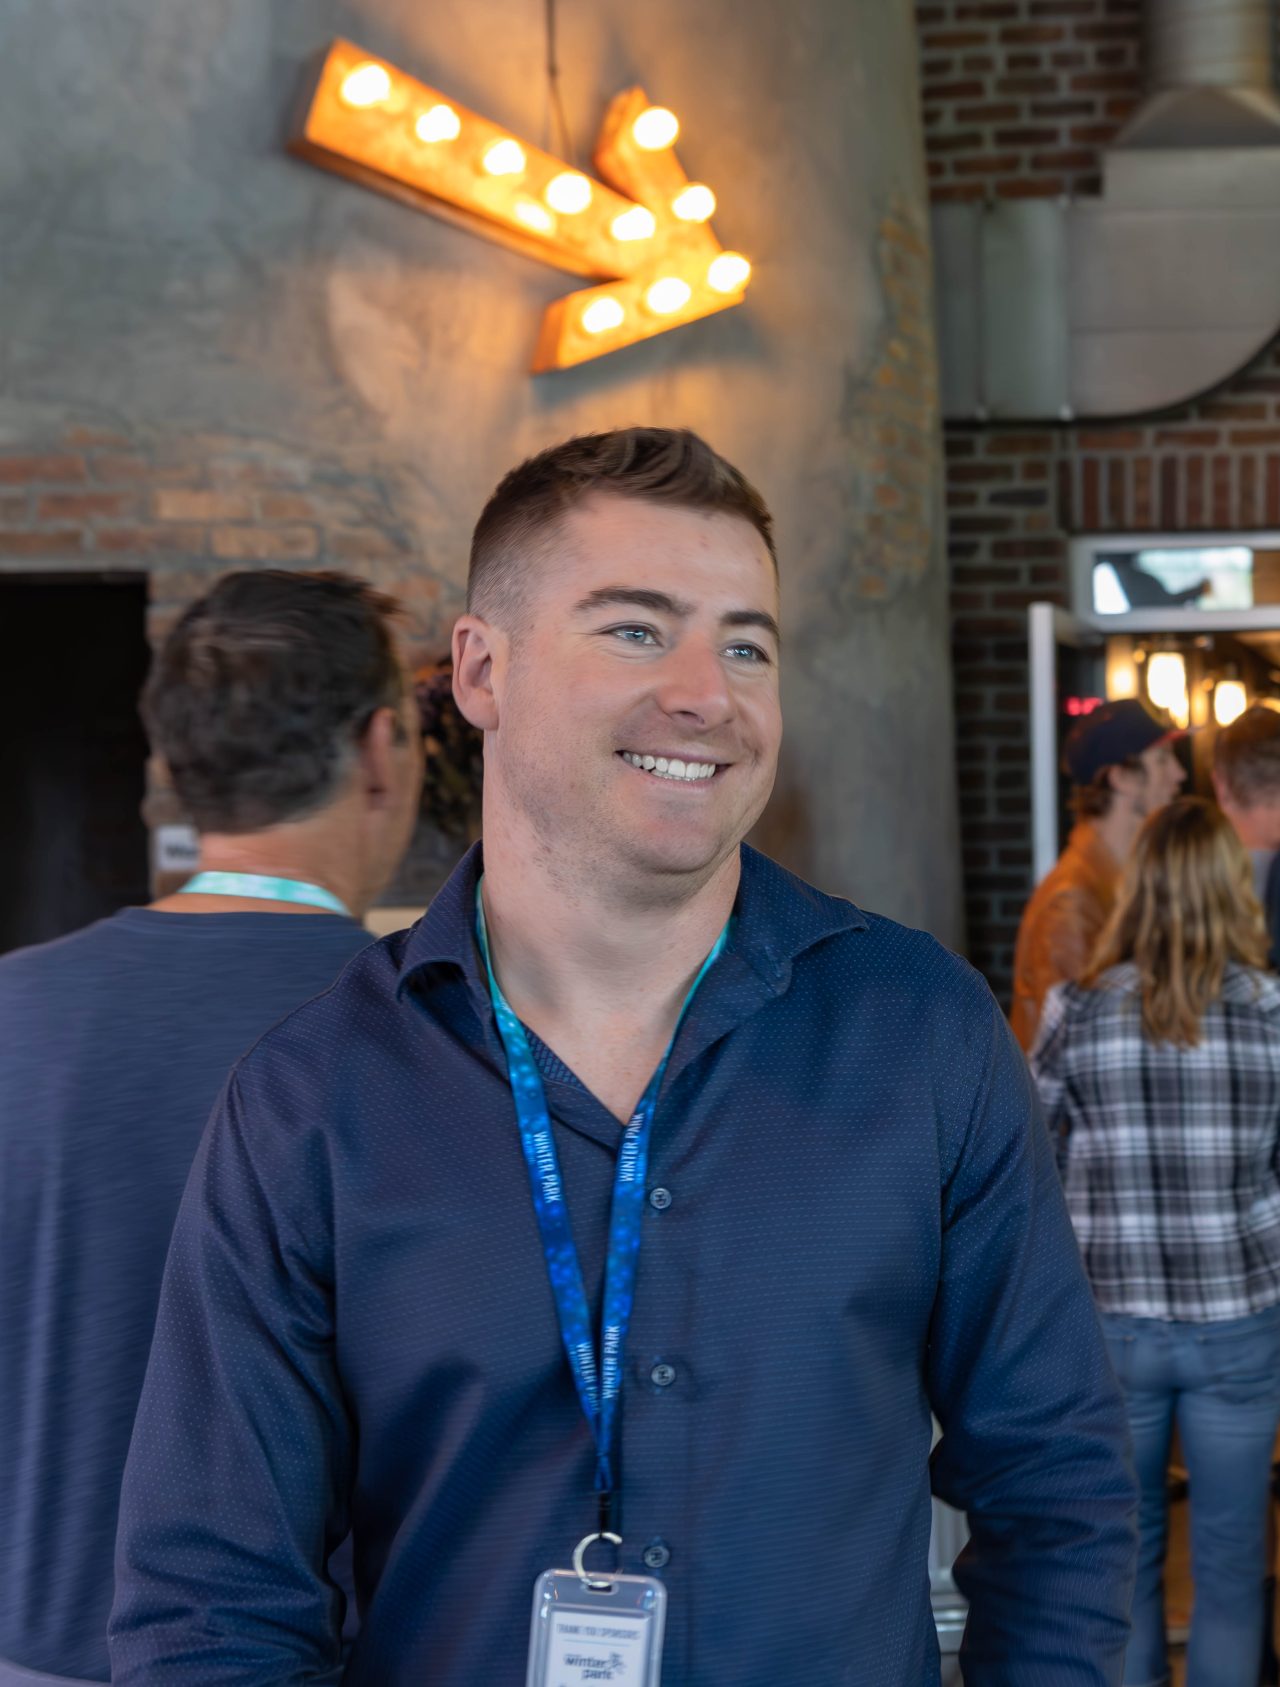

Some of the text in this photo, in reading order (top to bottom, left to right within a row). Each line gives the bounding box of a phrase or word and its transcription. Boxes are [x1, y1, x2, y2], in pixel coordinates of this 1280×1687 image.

[533, 1131, 562, 1204] WINTER PARK
[618, 1113, 645, 1182] WINTER PARK
[576, 1341, 596, 1383] WINTER
[602, 1325, 620, 1399] WINTER PARK
[564, 1655, 607, 1669] winter
